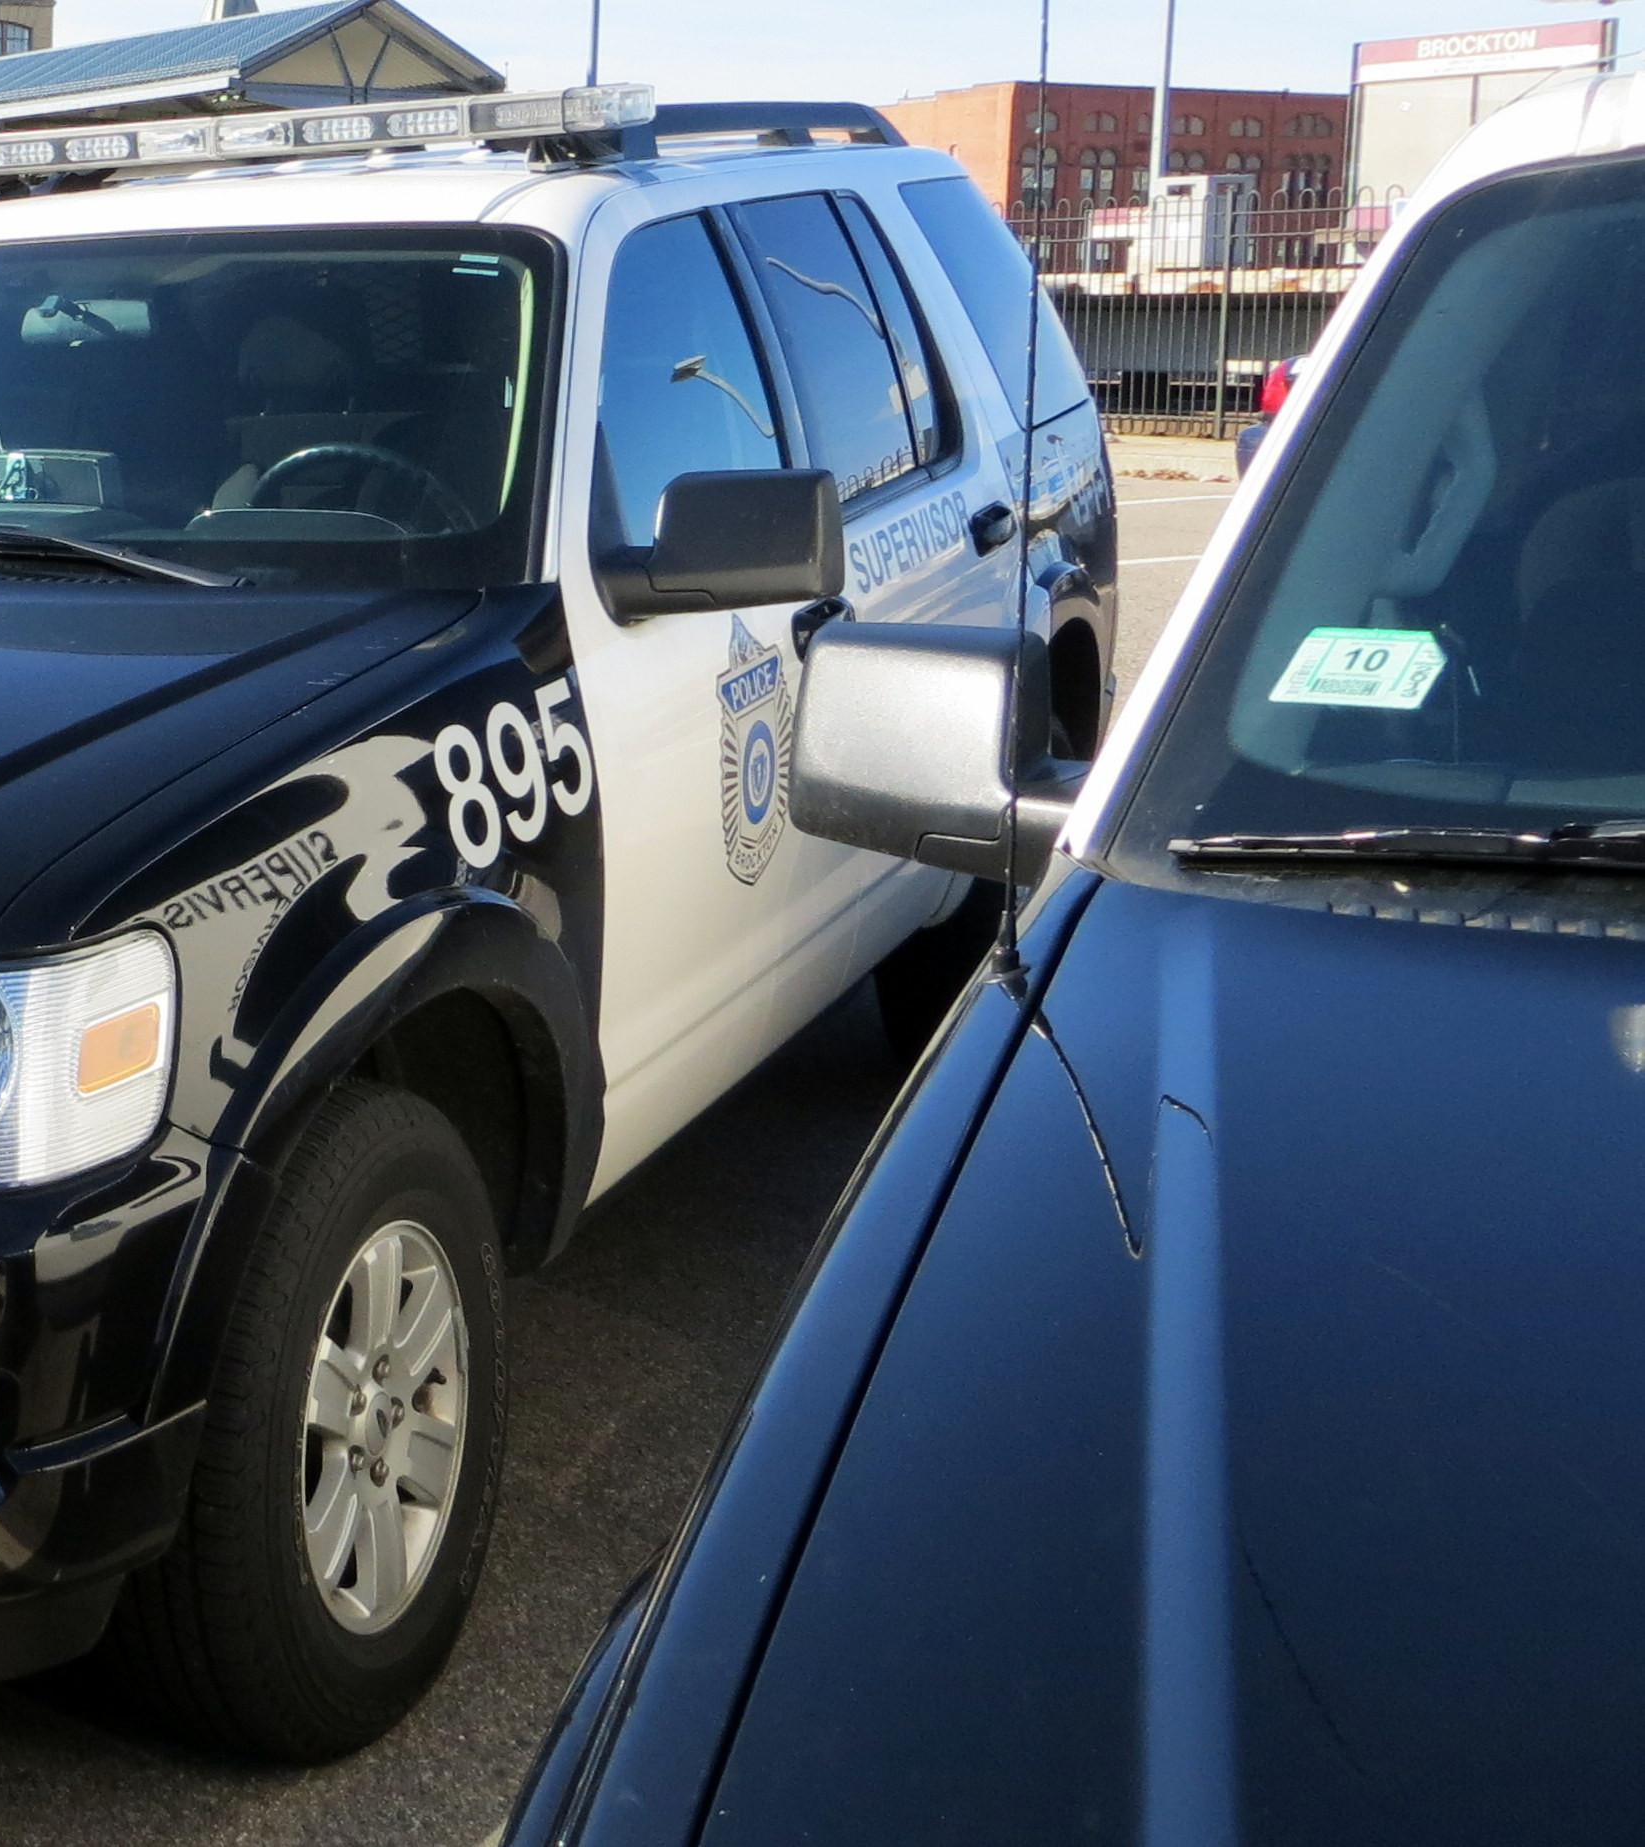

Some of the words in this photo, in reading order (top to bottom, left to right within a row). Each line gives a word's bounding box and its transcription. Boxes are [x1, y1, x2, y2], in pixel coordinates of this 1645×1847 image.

[1417, 29, 1538, 59] BROCKTON
[849, 489, 971, 594] SUPERVISOR
[1344, 647, 1390, 672] 10
[729, 663, 775, 711] POLICE
[433, 676, 593, 869] 895
